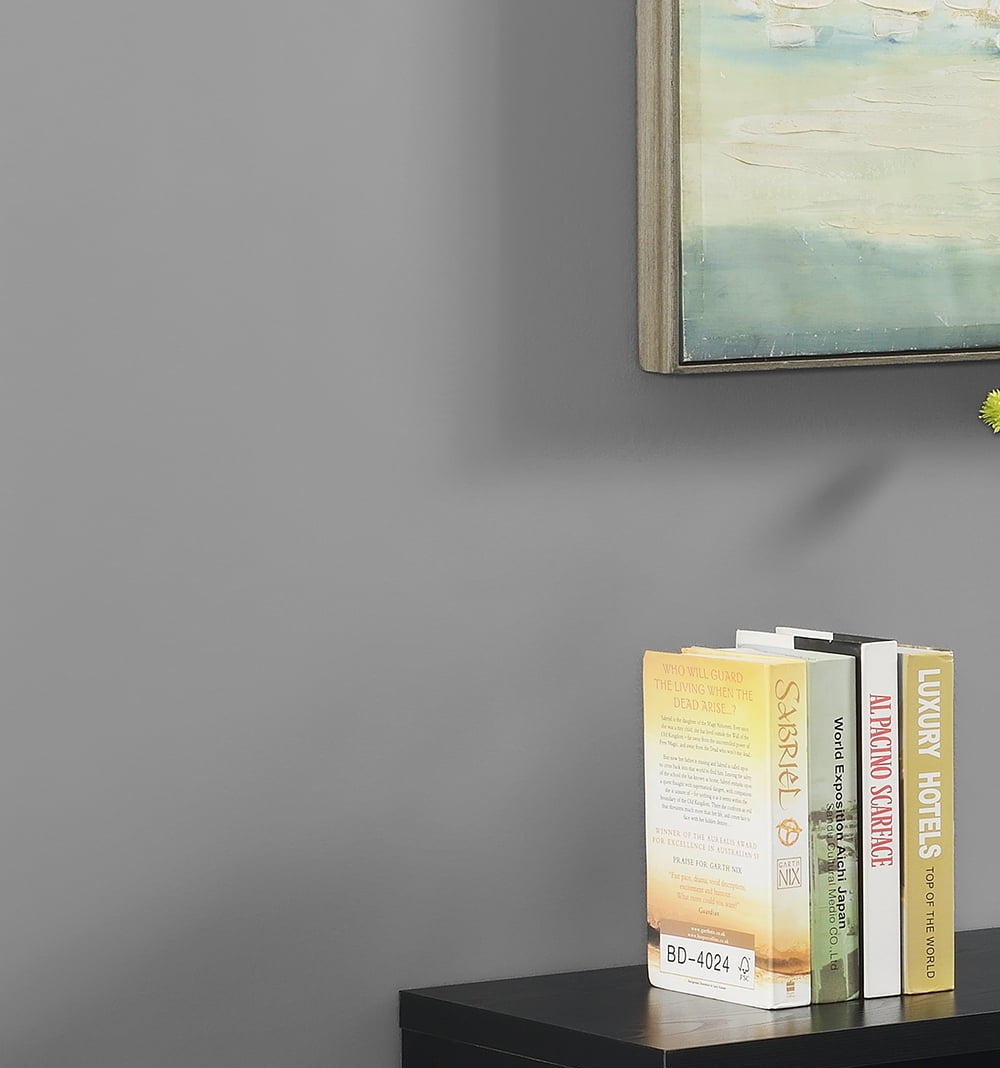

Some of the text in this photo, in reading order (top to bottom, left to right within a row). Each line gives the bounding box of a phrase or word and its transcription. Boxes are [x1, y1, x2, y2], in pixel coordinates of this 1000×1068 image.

[662, 663, 744, 684] WHO WILL GUARD
[653, 678, 753, 702] THE LIVING WHEN THE
[673, 697, 699, 711] DEAD
[917, 668, 942, 860] LUXURY HOTELS
[869, 693, 894, 868] AL PACINO SCARFACE
[833, 716, 847, 929] World Exposition Aichi Japan
[682, 831, 693, 839] OF
[693, 832, 705, 841] THE
[672, 855, 743, 875] PRAISE FOR GARTH NIX
[778, 860, 801, 869] GARTH
[778, 867, 802, 887] NIX
[925, 866, 936, 979] TOP OF THE WORLD
[667, 944, 730, 973] BD-4024
